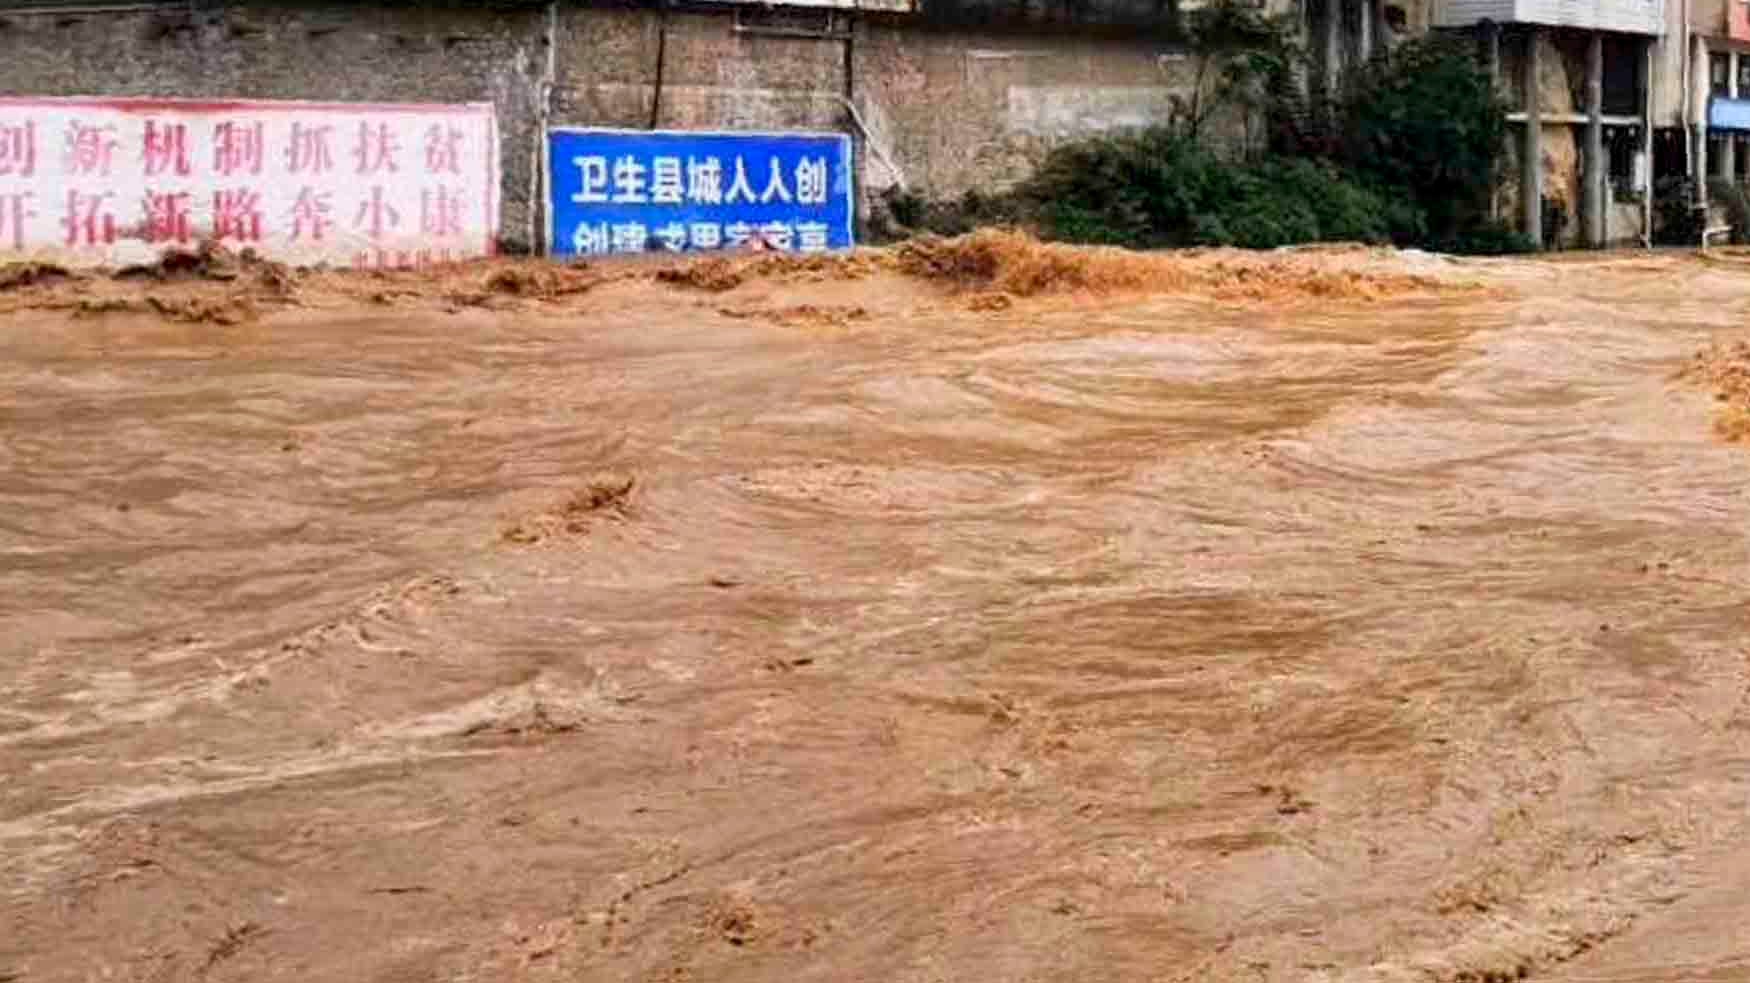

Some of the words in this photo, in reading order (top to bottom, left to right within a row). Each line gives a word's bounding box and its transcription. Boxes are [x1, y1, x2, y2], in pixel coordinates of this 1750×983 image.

[571, 154, 828, 204] 卫生县城人人创
